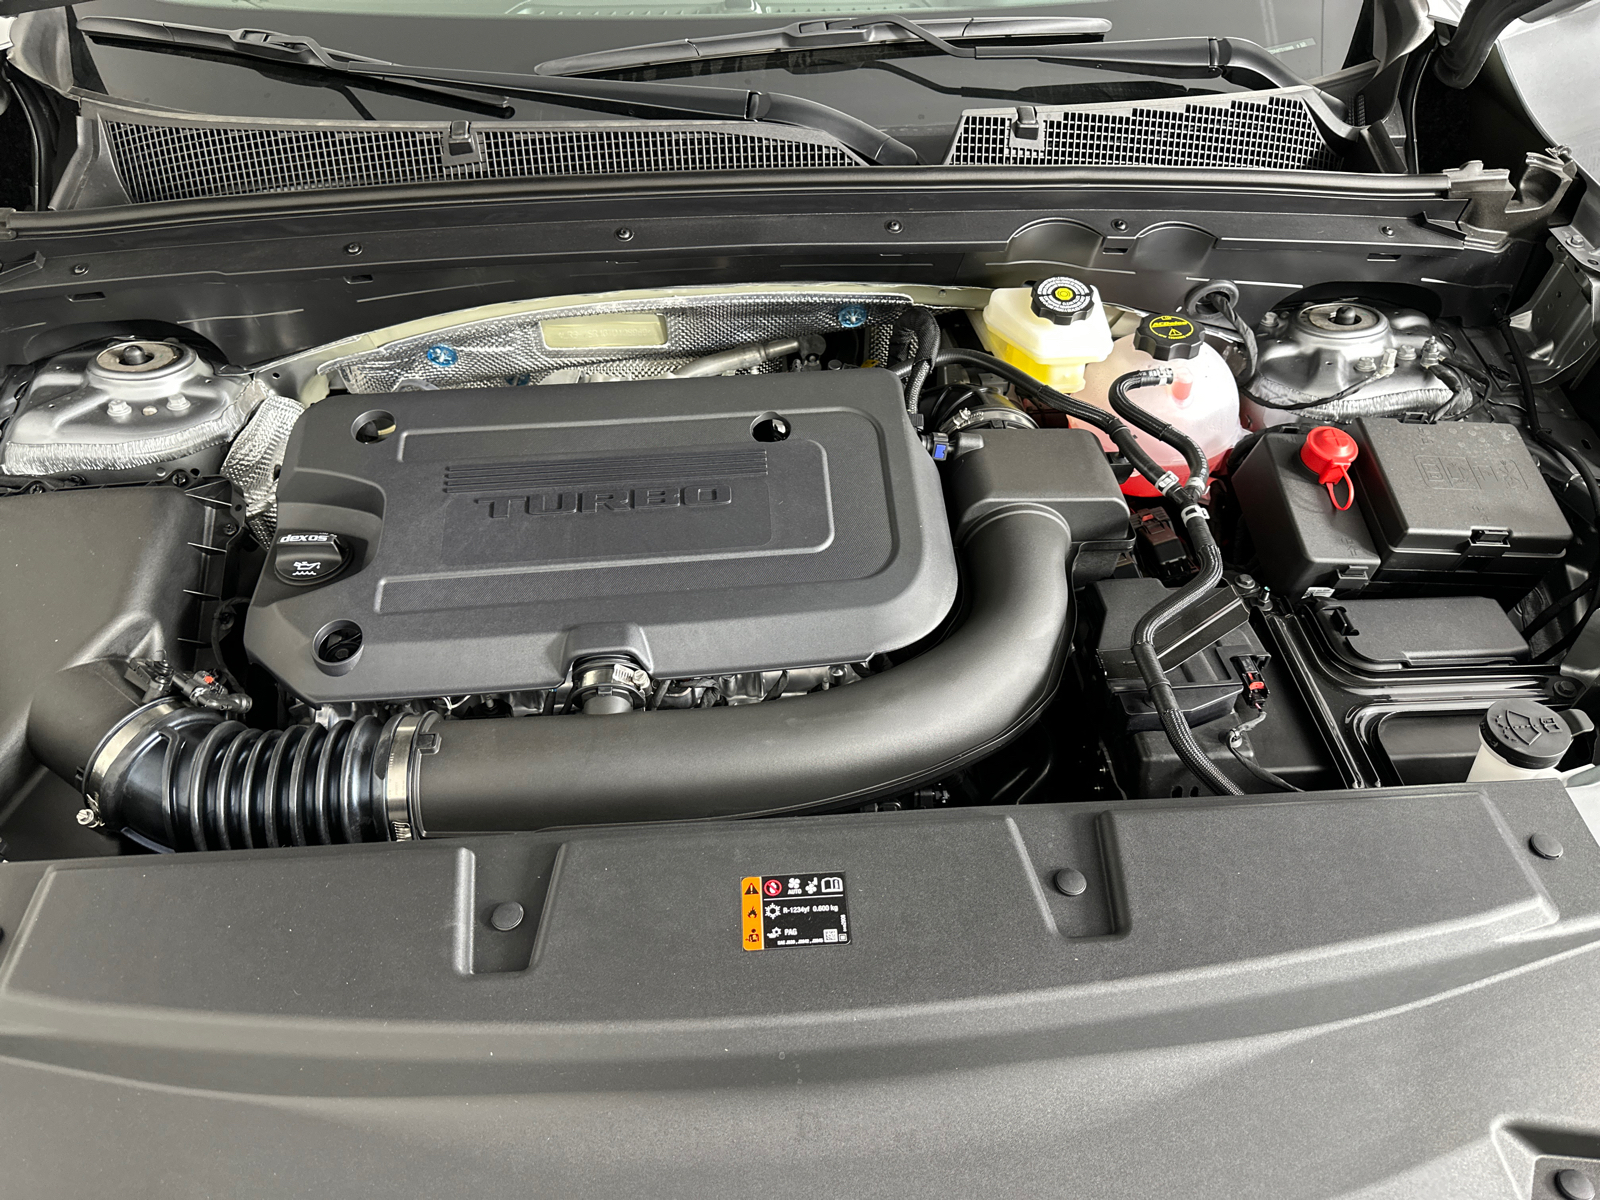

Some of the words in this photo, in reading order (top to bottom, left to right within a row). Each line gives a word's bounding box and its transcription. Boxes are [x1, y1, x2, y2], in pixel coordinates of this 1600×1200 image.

[474, 484, 732, 519] TURBO
[280, 534, 329, 543] dexos
[782, 906, 810, 914] R-1234yf
[830, 904, 838, 912] kg
[784, 928, 798, 936] PAG
